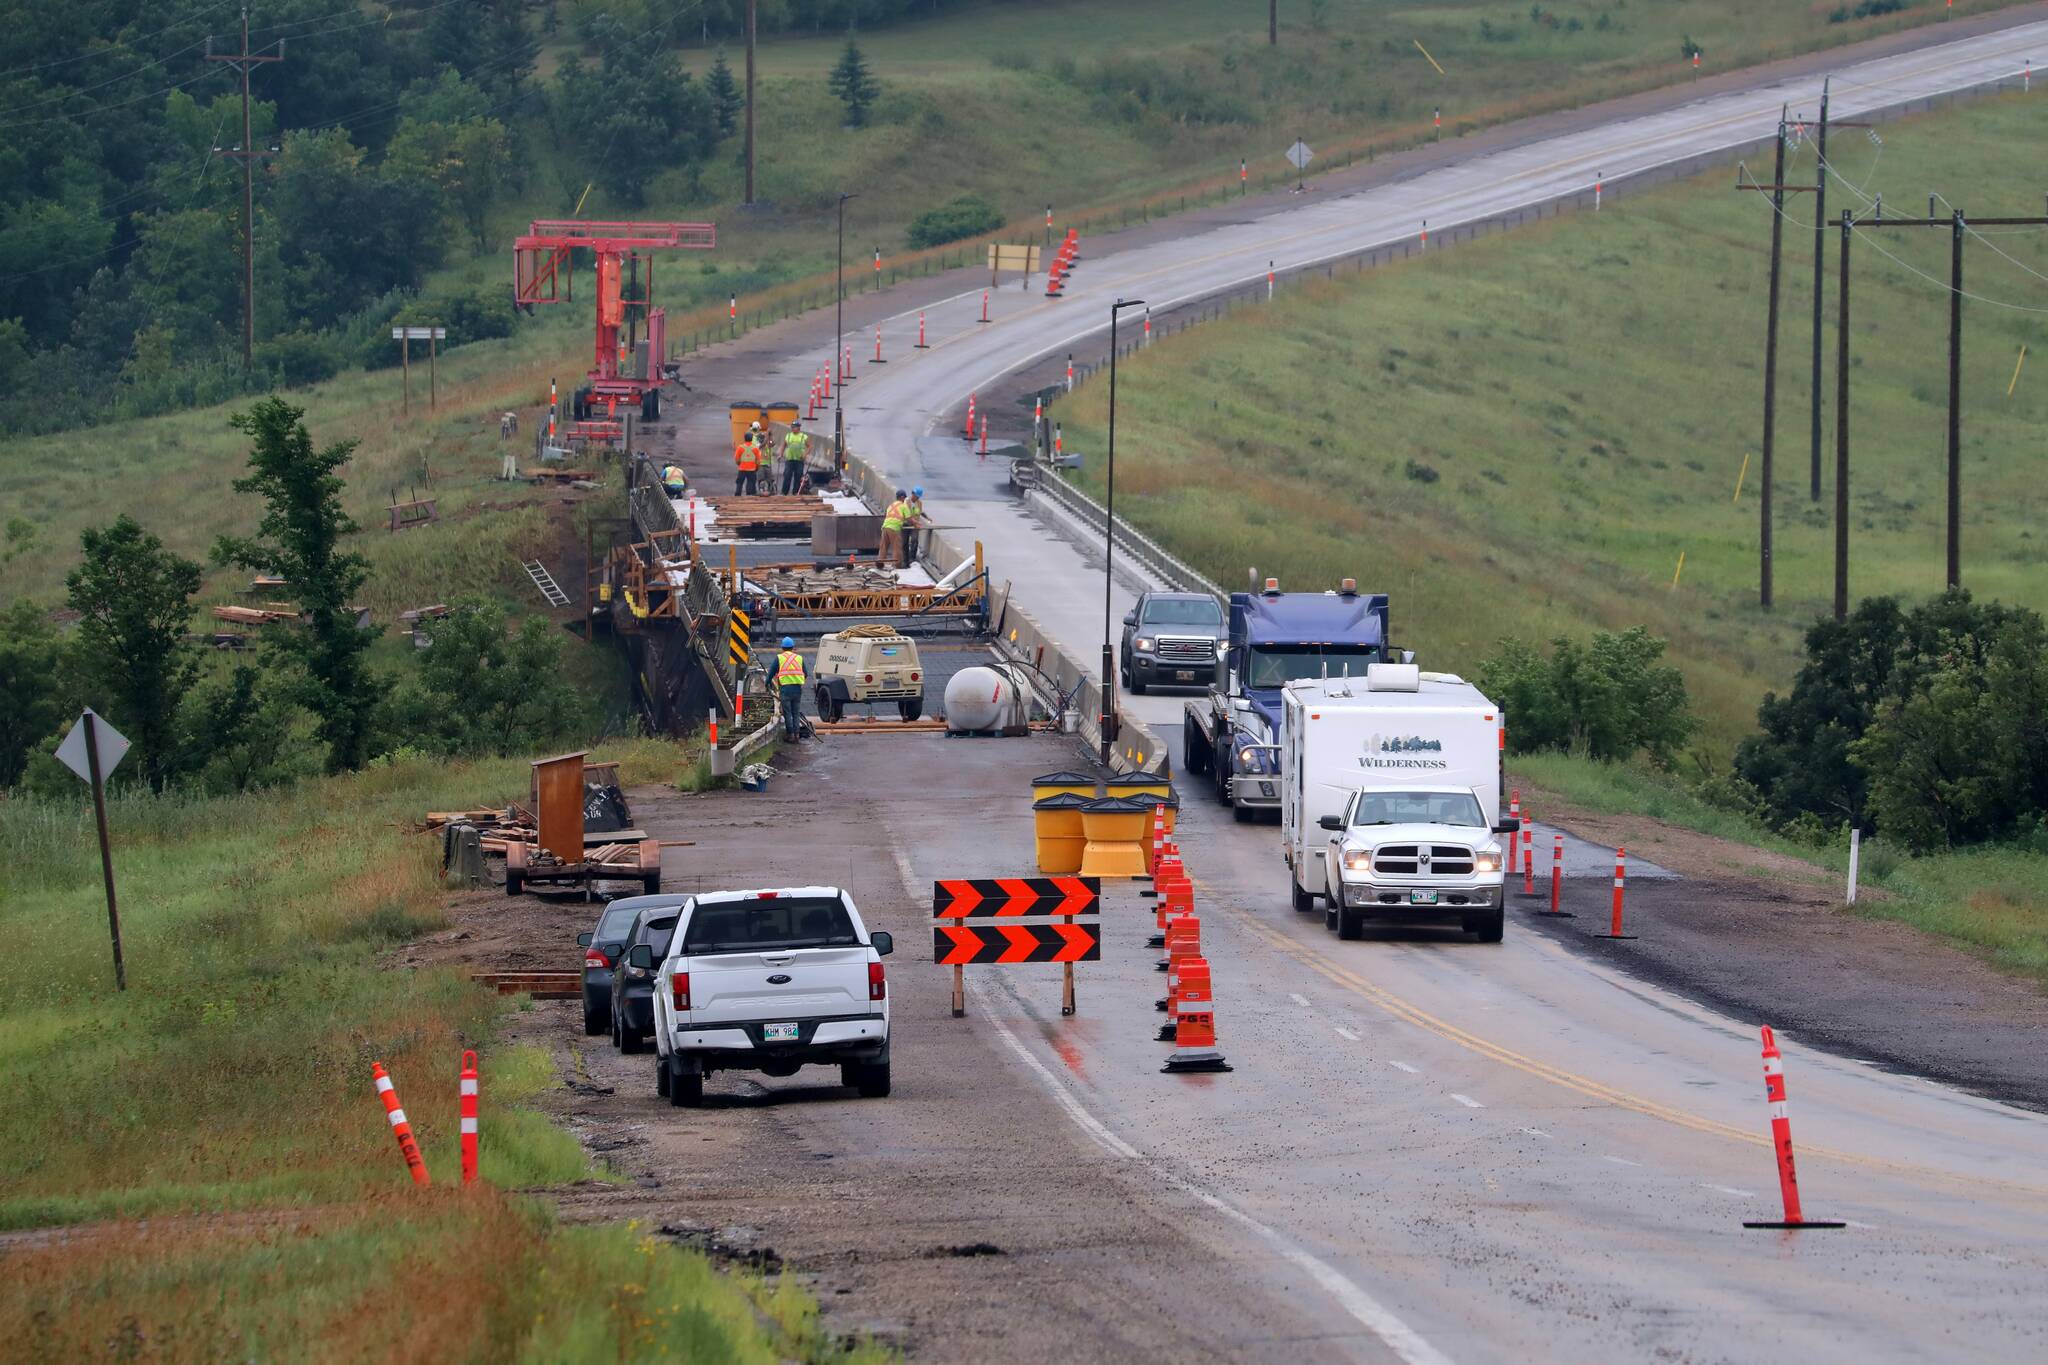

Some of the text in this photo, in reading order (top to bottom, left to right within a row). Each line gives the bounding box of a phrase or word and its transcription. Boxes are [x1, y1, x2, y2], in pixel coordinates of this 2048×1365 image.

[1358, 757, 1447, 769] WILDERNESS
[765, 1027, 798, 1037] KHM 982
